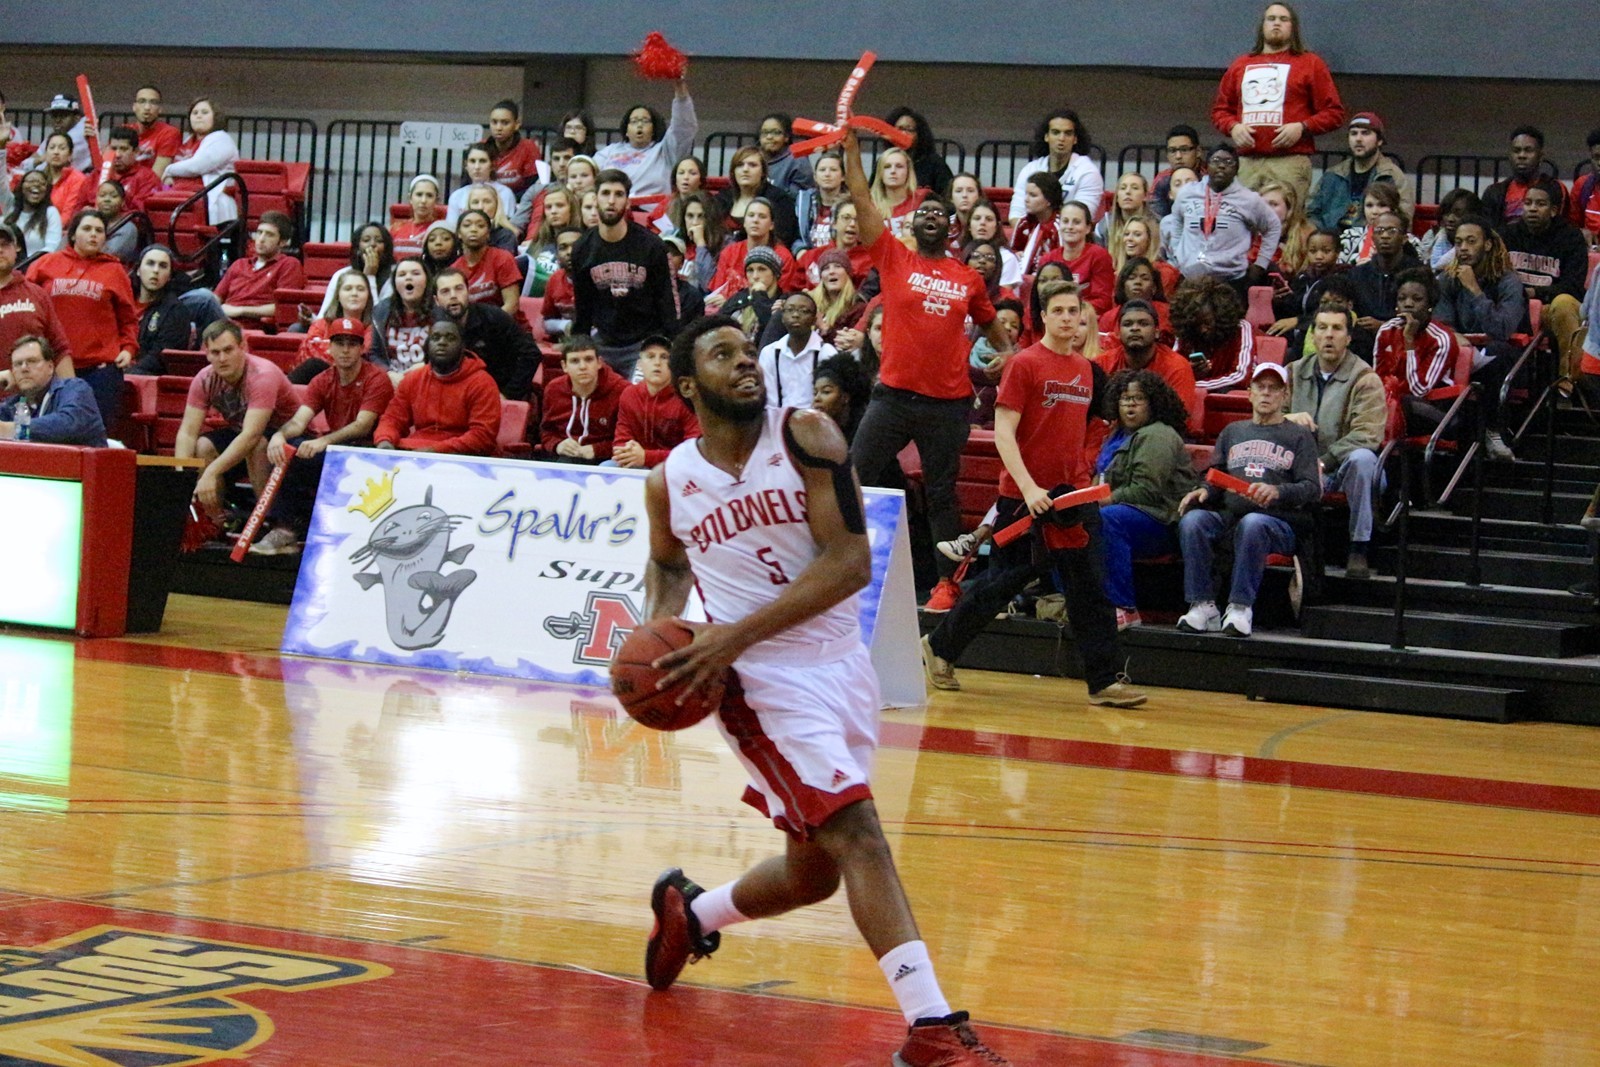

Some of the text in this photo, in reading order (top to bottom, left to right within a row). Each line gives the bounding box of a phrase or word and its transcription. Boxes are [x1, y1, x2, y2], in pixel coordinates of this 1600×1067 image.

[907, 271, 968, 298] NICHOLLS
[911, 285, 929, 295] STATE
[396, 344, 425, 363] GO
[1229, 439, 1295, 470] NICHOLLS
[478, 489, 638, 561] Spahr's
[756, 546, 790, 585] 5
